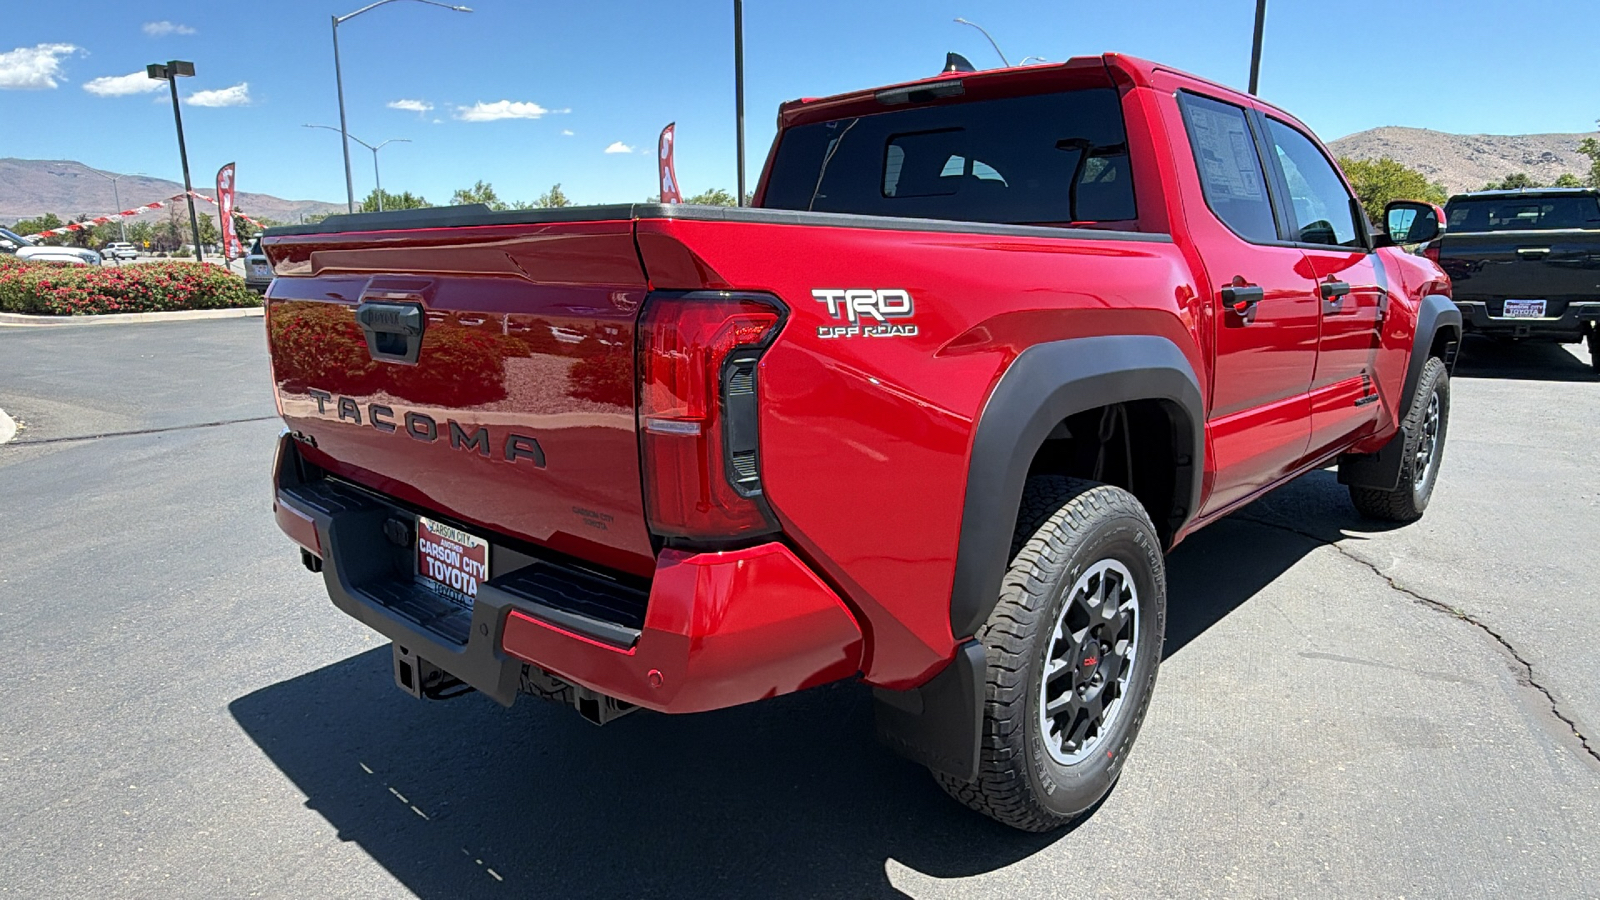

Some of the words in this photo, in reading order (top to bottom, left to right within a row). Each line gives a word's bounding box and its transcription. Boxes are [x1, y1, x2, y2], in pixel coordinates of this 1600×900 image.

[811, 289, 914, 326] TRD
[816, 326, 859, 339] OFF
[862, 325, 919, 338] ROAD
[308, 388, 547, 469] TACOMA
[432, 521, 456, 540] CARSON
[457, 532, 471, 547] CITY
[419, 538, 461, 568] CARSON
[462, 556, 485, 579] CITY
[426, 556, 478, 597] TOYOTA
